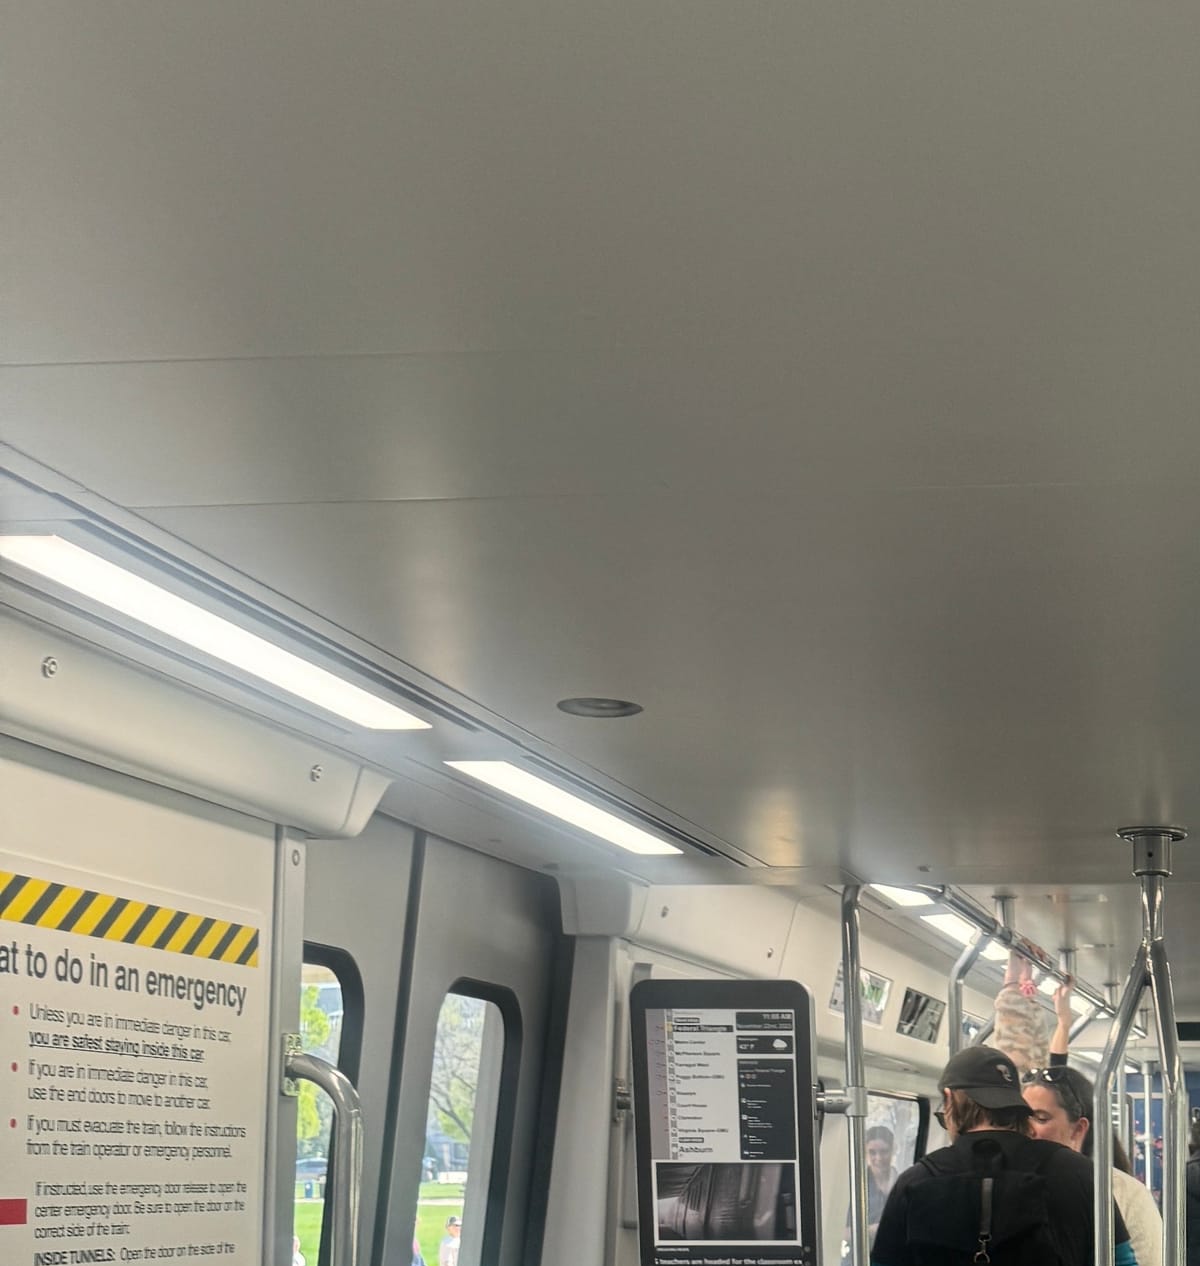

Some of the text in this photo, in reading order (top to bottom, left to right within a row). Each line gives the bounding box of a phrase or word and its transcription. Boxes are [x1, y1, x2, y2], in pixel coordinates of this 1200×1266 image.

[27, 943, 48, 979] to
[55, 948, 83, 984] do
[90, 953, 108, 988] in
[115, 965, 140, 993] an
[146, 969, 247, 1016] emergency
